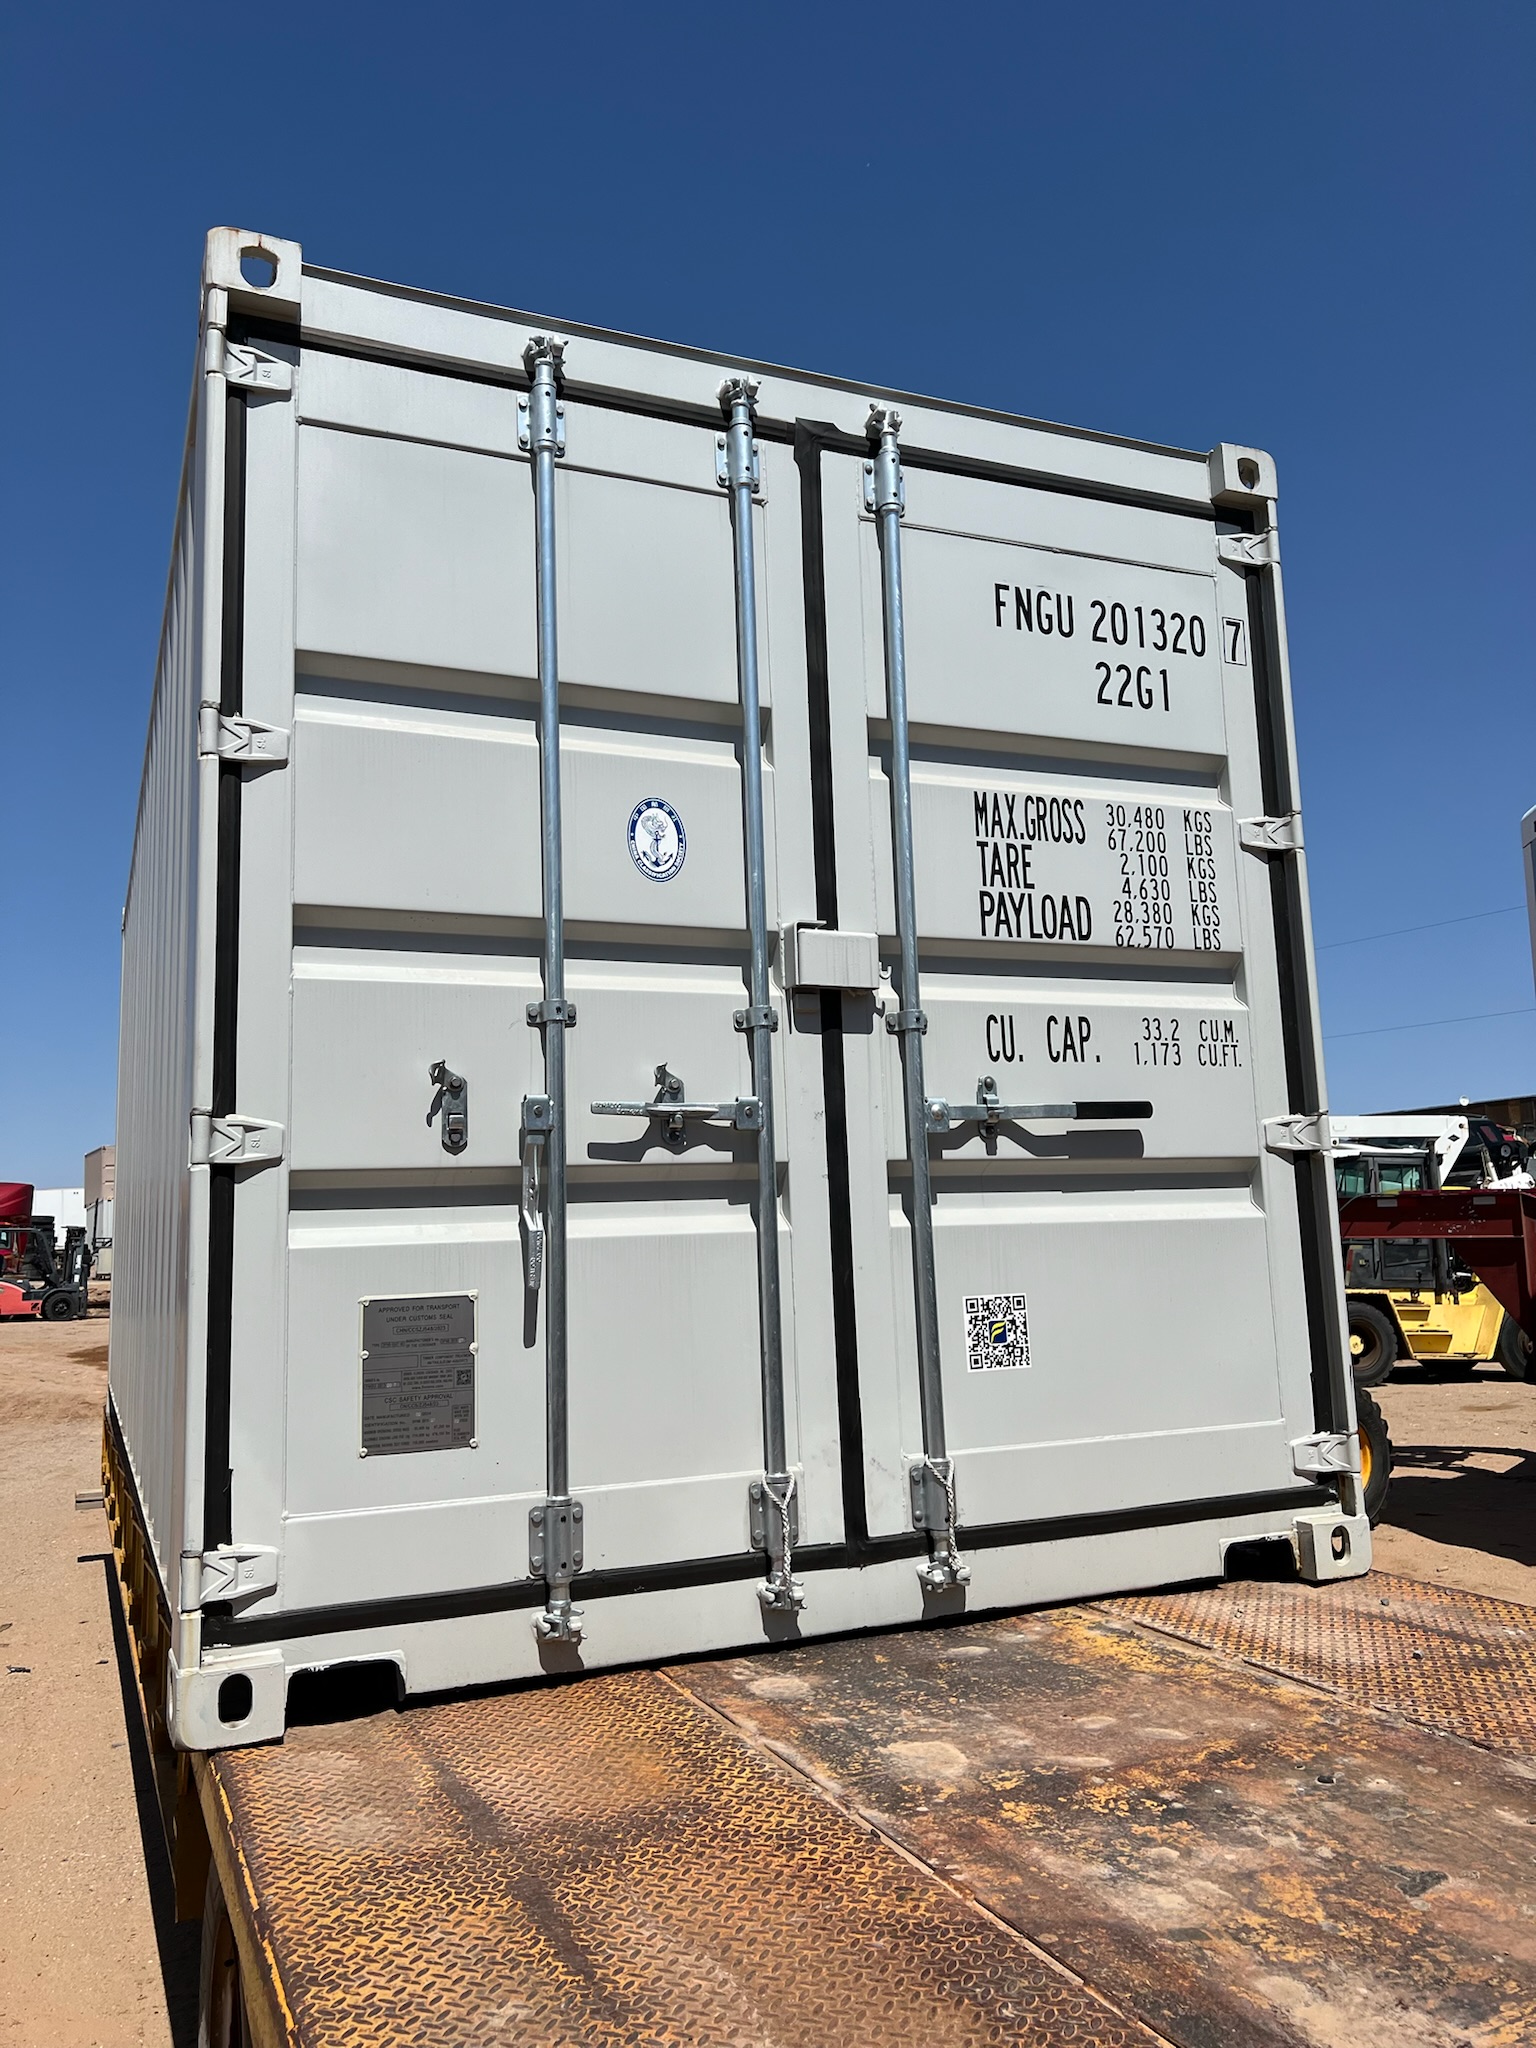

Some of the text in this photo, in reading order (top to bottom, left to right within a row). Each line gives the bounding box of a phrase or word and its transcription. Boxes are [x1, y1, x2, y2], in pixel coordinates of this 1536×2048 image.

[995, 583, 1241, 662] FNGU 201320 7
[1096, 662, 1169, 711] 22G1
[974, 791, 1212, 846] MAX.GROSS 30,480 KGS
[1108, 829, 1212, 857] 67,200 LBS
[976, 841, 1215, 889] TARE 2,100 KGS
[1122, 876, 1217, 903] 4,630 LBS
[980, 891, 1220, 940] PAYLOAD 28,380 KGS
[1116, 926, 1221, 951] 62,570 LBS
[986, 1015, 1239, 1062] CU. CAP. 33.2 CU.M.
[1134, 1042, 1242, 1066] 1,173 CU.FT.
[378, 1305, 410, 1313] APPROVED
[426, 1303, 460, 1311] TRANSPORT
[408, 1314, 437, 1322] CUSTOMS
[399, 1395, 421, 1403] SAFETY
[423, 1393, 453, 1401] APPROVAL
